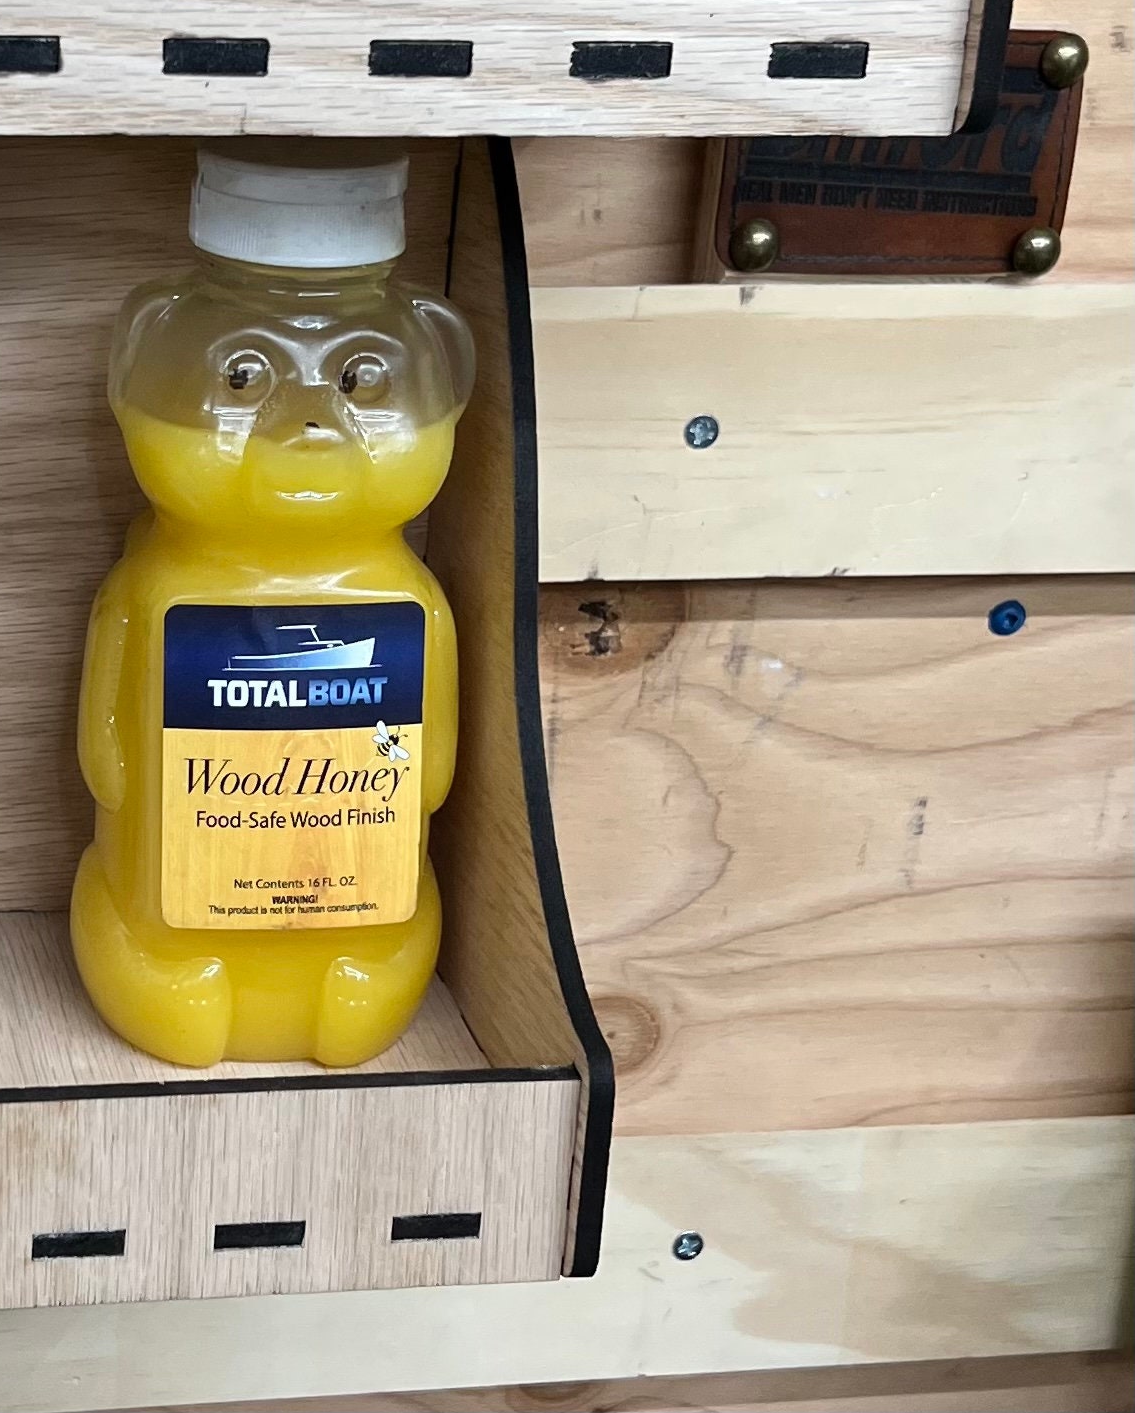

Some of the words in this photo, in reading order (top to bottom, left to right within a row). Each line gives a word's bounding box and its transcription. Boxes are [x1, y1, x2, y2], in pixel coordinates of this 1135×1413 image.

[183, 757, 291, 796] Wood
[292, 757, 410, 802] Honey
[196, 810, 287, 829] Food-Safe
[290, 809, 342, 828] Wood
[346, 806, 396, 826] Finish
[233, 878, 254, 889] Net
[255, 877, 305, 889] Contents
[308, 877, 320, 888] 16
[271, 894, 319, 905] WARNING!
[208, 905, 226, 914] This
[227, 905, 259, 917] product
[260, 905, 268, 914] is
[269, 905, 283, 914] not
[284, 904, 295, 914] for
[297, 905, 326, 914] human
